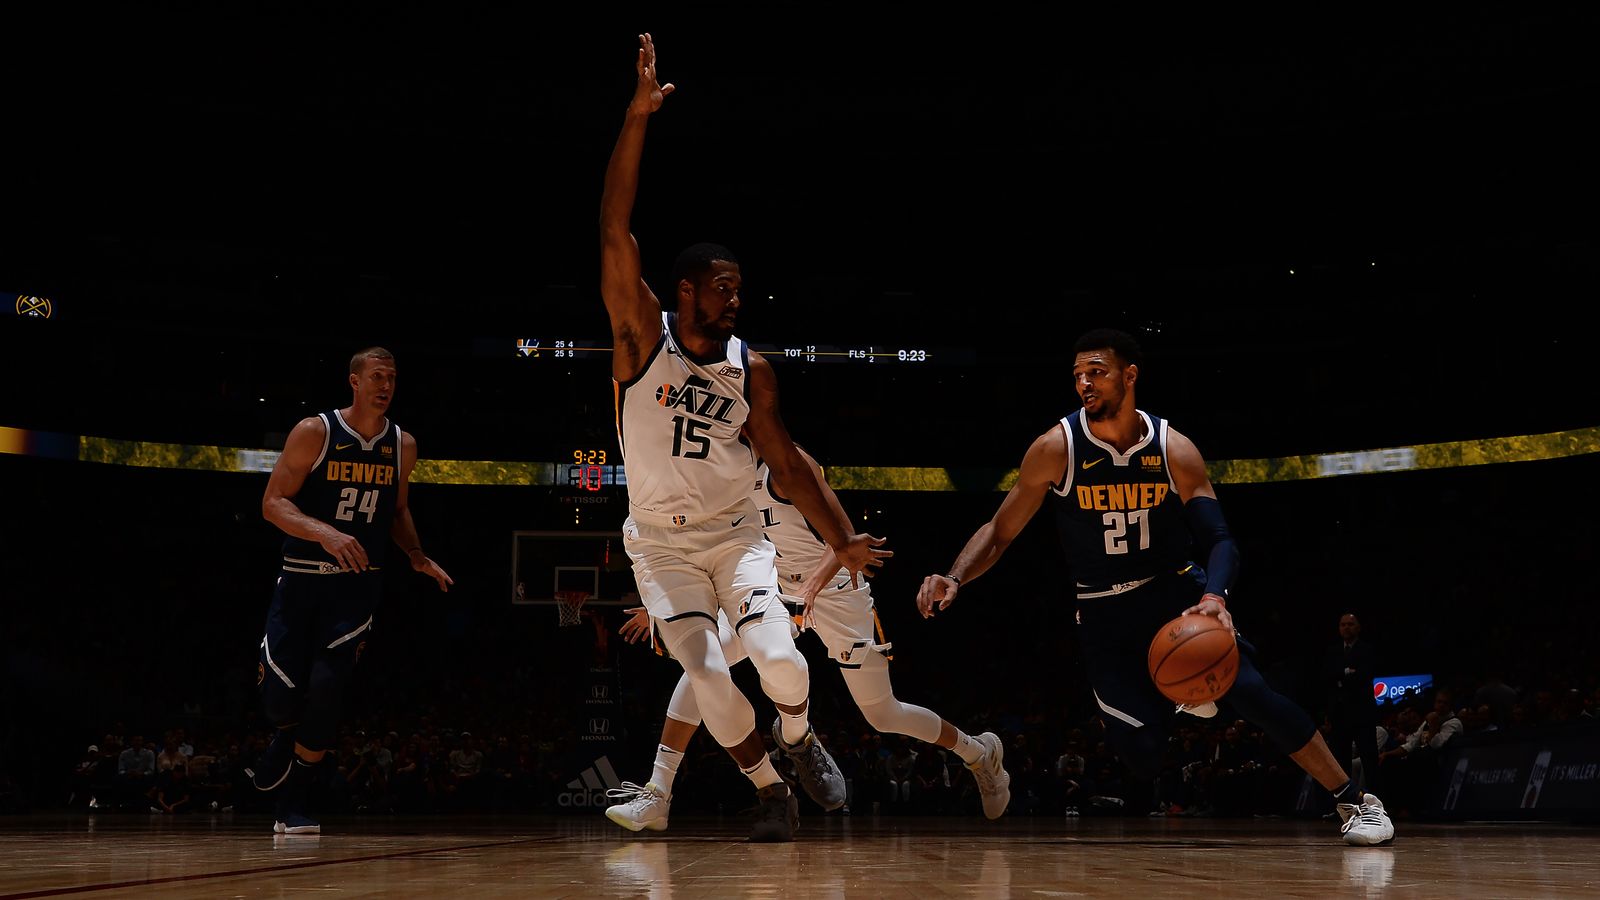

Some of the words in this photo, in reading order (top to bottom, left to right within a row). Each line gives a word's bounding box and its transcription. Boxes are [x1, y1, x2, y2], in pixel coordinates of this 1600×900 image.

[784, 349, 802, 358] TOT
[849, 350, 866, 358] FLS
[898, 350, 926, 361] 9:23
[656, 375, 737, 424] JAZZ
[671, 415, 713, 460] 15
[573, 450, 607, 465] 9:23
[1141, 455, 1162, 466] WU
[326, 460, 394, 486] DENVER
[578, 465, 602, 491] 10
[335, 487, 380, 524] 24
[572, 496, 609, 504] TISSOT
[1076, 483, 1169, 511] DENVER
[1102, 509, 1151, 555] 27
[1567, 763, 1597, 780] MILLER
